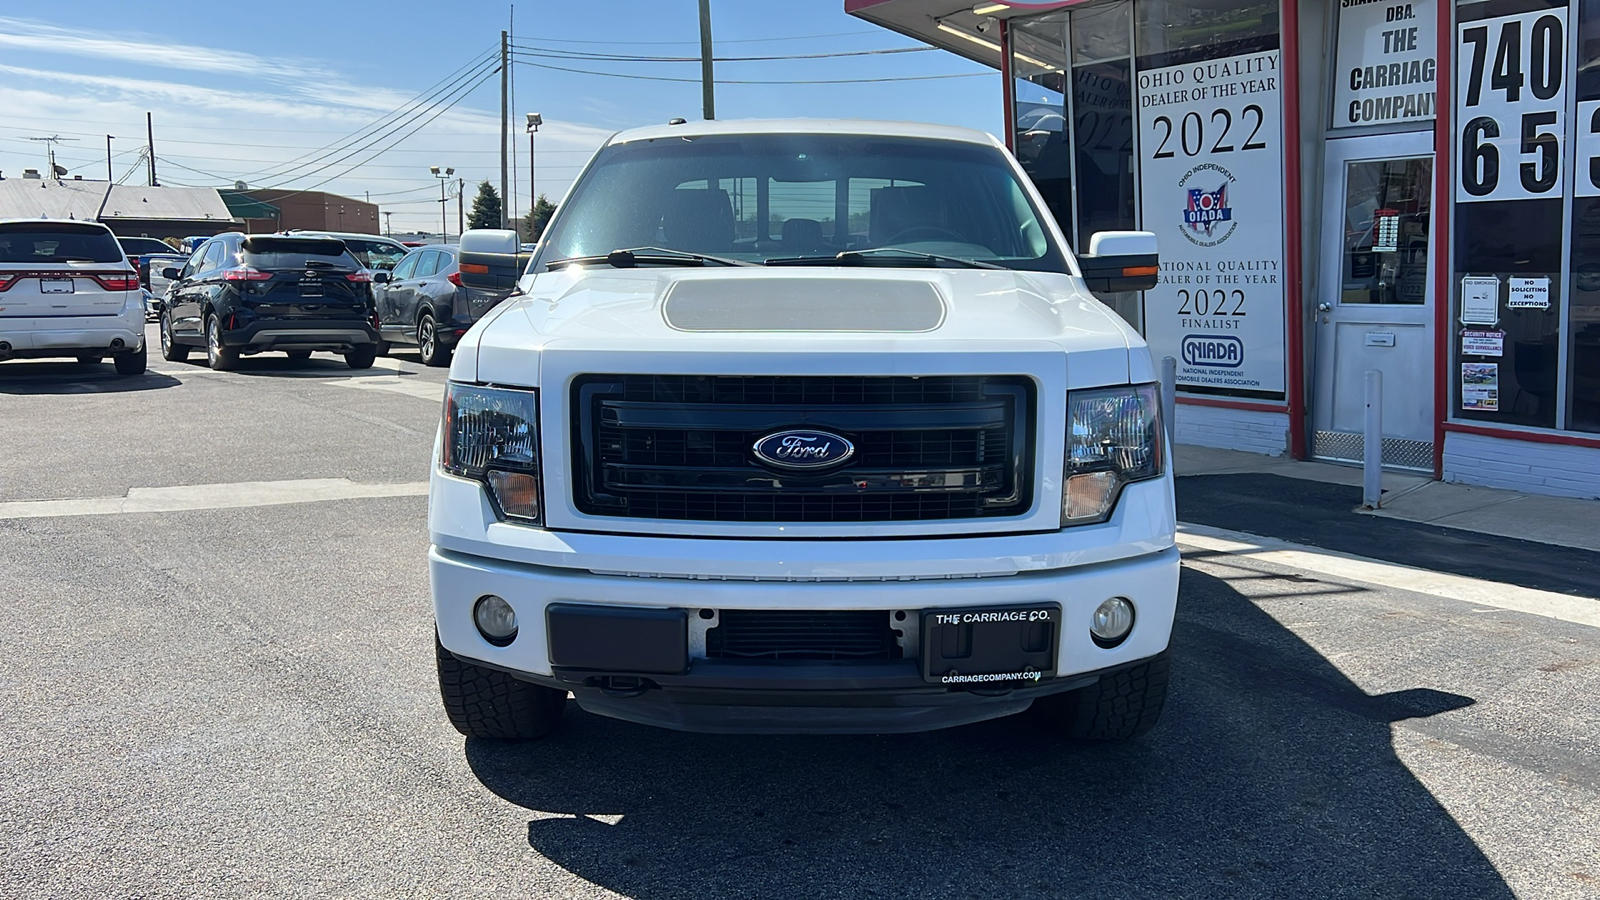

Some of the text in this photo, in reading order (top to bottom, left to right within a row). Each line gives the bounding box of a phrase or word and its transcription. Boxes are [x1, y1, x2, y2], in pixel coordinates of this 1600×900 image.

[1386, 4, 1416, 22] DBA.
[1382, 27, 1418, 54] THE
[1462, 14, 1563, 107] 740
[1078, 71, 1112, 91] HIO
[1139, 70, 1184, 89] OHIO
[1193, 54, 1278, 83] QUALITY
[1350, 58, 1436, 91] CARRIAG
[1142, 77, 1276, 108] DEALER OF THE YEAR
[1152, 104, 1266, 159] 2022
[1178, 163, 1237, 187] OHIO INDEPENDENT
[1189, 209, 1224, 222] OIADA
[1178, 224, 1199, 245] AUTOMOBILE
[1216, 221, 1238, 245] ASSOCIATION
[1157, 260, 1279, 272] ATIONAL QUALITY
[1156, 274, 1278, 284] EALER OF THE YEAR
[1177, 288, 1247, 317] 2022
[1181, 318, 1240, 329] FINALIST
[1186, 341, 1237, 361] NIADA
[1183, 367, 1244, 377] NATIONAL INDEPENDENT
[1201, 376, 1223, 384] DEALERS
[1224, 378, 1260, 387] ASSOCIATION
[776, 435, 831, 459] Ford
[936, 610, 1050, 625] THE CARRIAGE CO.
[942, 671, 1041, 684] CARRIAGECOMPANY.COM
